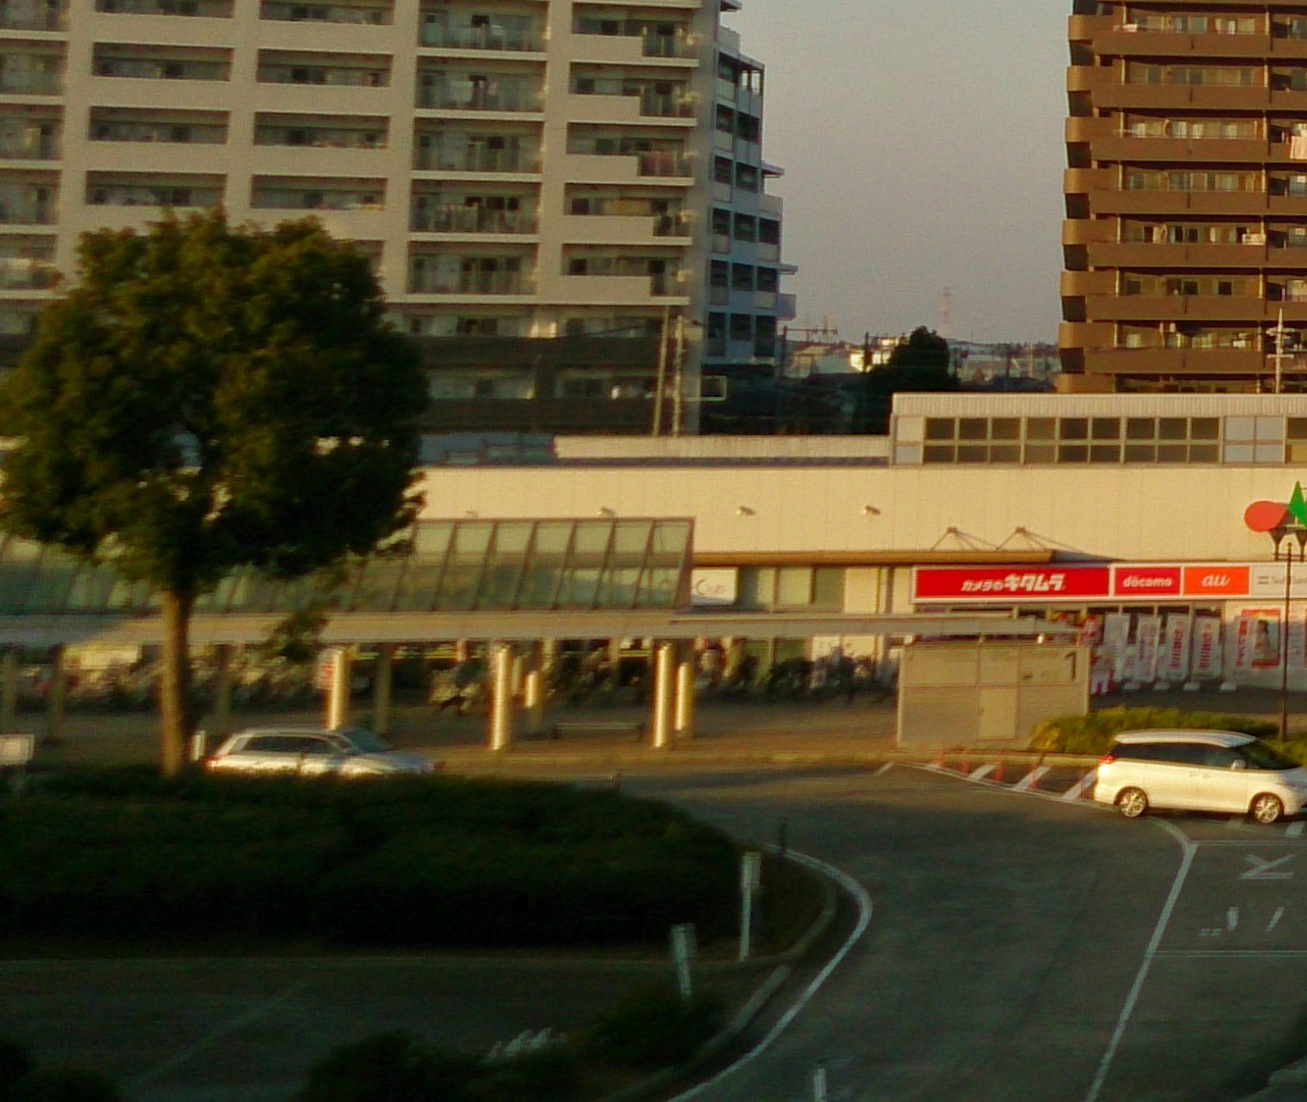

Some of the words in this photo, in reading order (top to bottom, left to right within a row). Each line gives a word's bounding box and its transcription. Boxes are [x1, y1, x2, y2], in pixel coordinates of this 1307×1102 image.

[961, 573, 1066, 592] カメラのキタムラ
[1122, 574, 1173, 587] docomo
[1202, 574, 1230, 587] au
